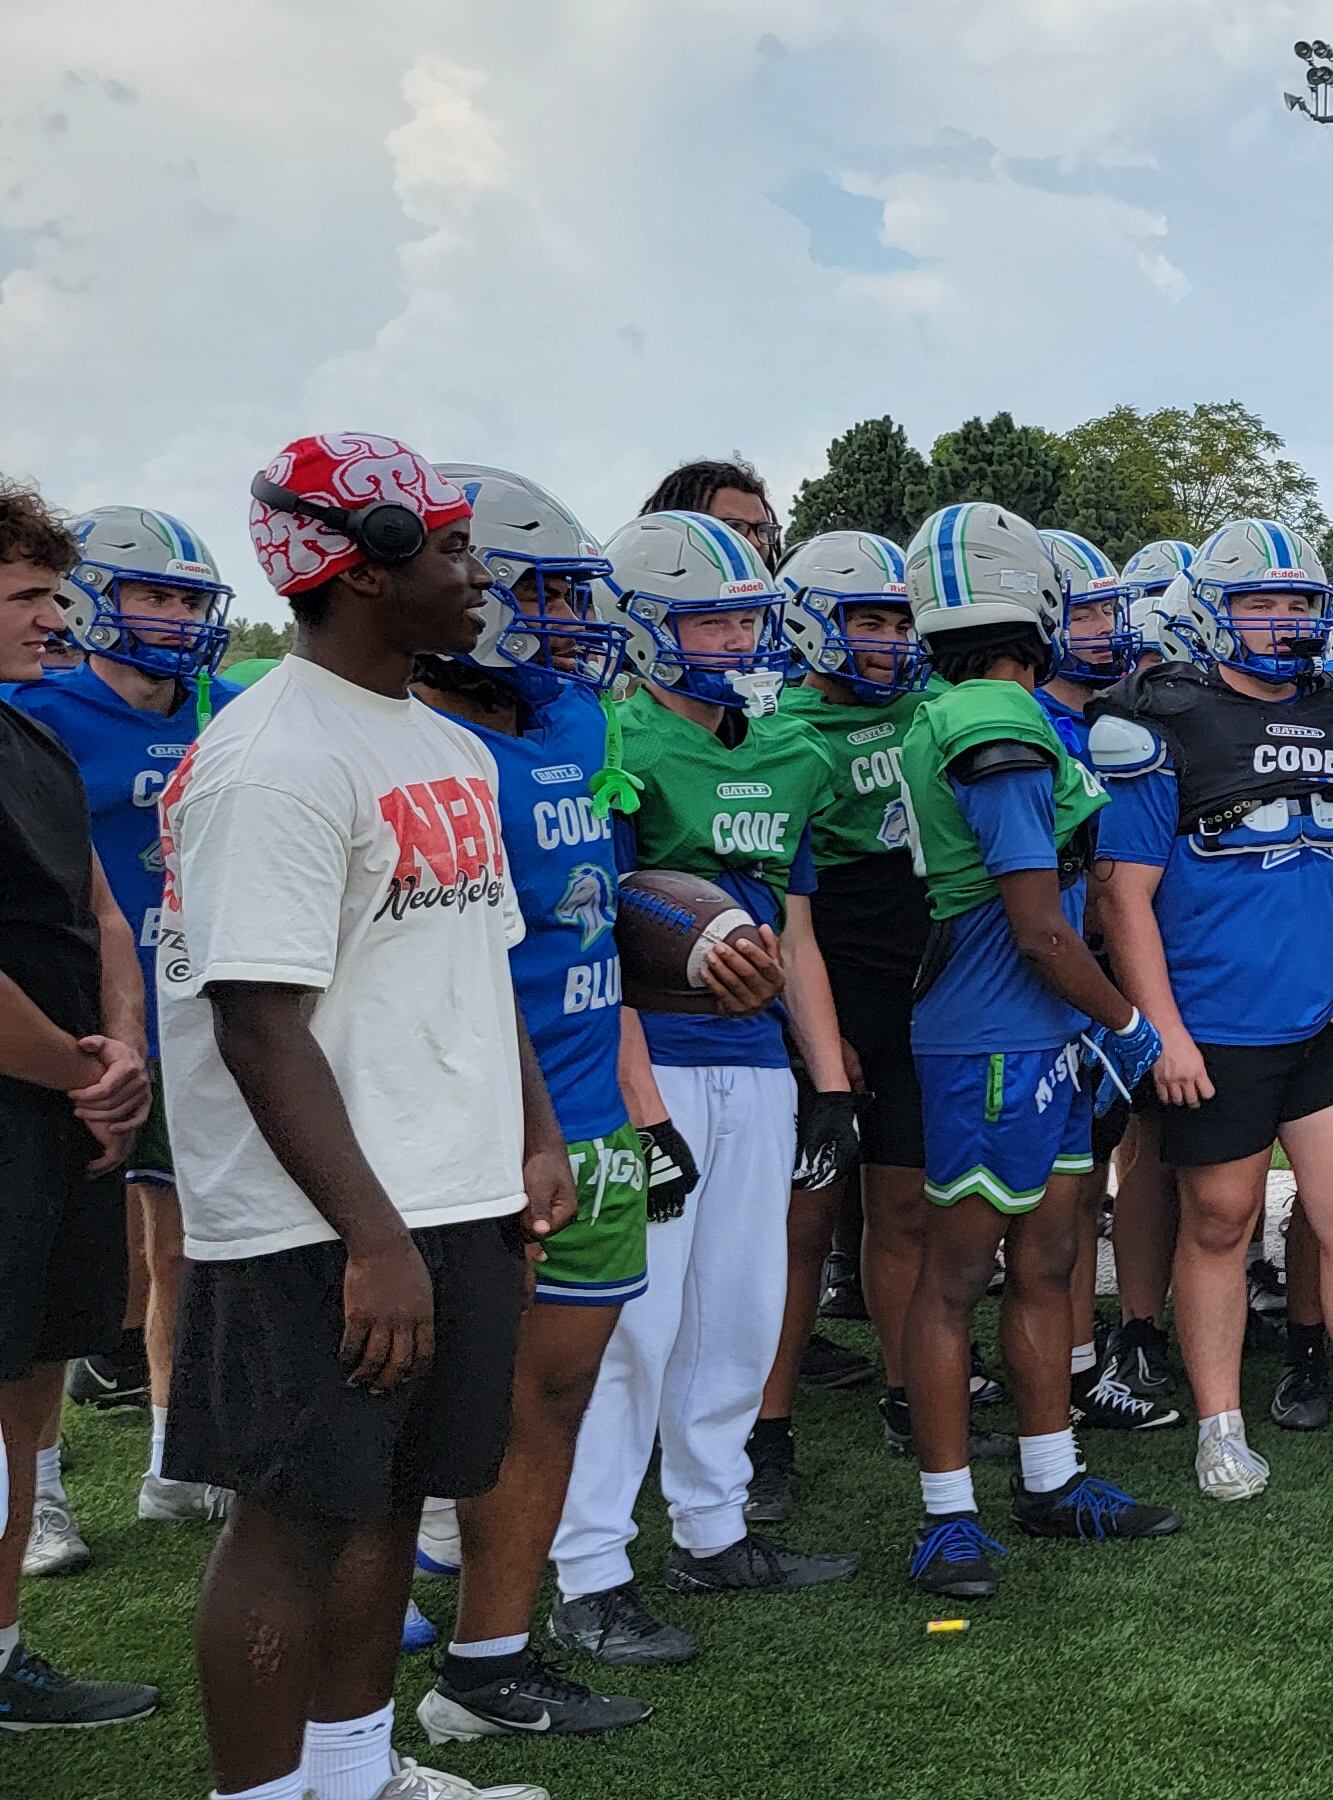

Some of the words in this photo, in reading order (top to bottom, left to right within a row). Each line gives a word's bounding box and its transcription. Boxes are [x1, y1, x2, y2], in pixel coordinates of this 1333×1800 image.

[728, 582, 764, 593] Riddell
[1271, 727, 1320, 737] BATTLE
[537, 768, 580, 781] BATTLE
[852, 746, 903, 795] COD
[722, 786, 767, 796] BATTLE
[712, 812, 790, 855] CODE
[564, 953, 622, 1015] BLU
